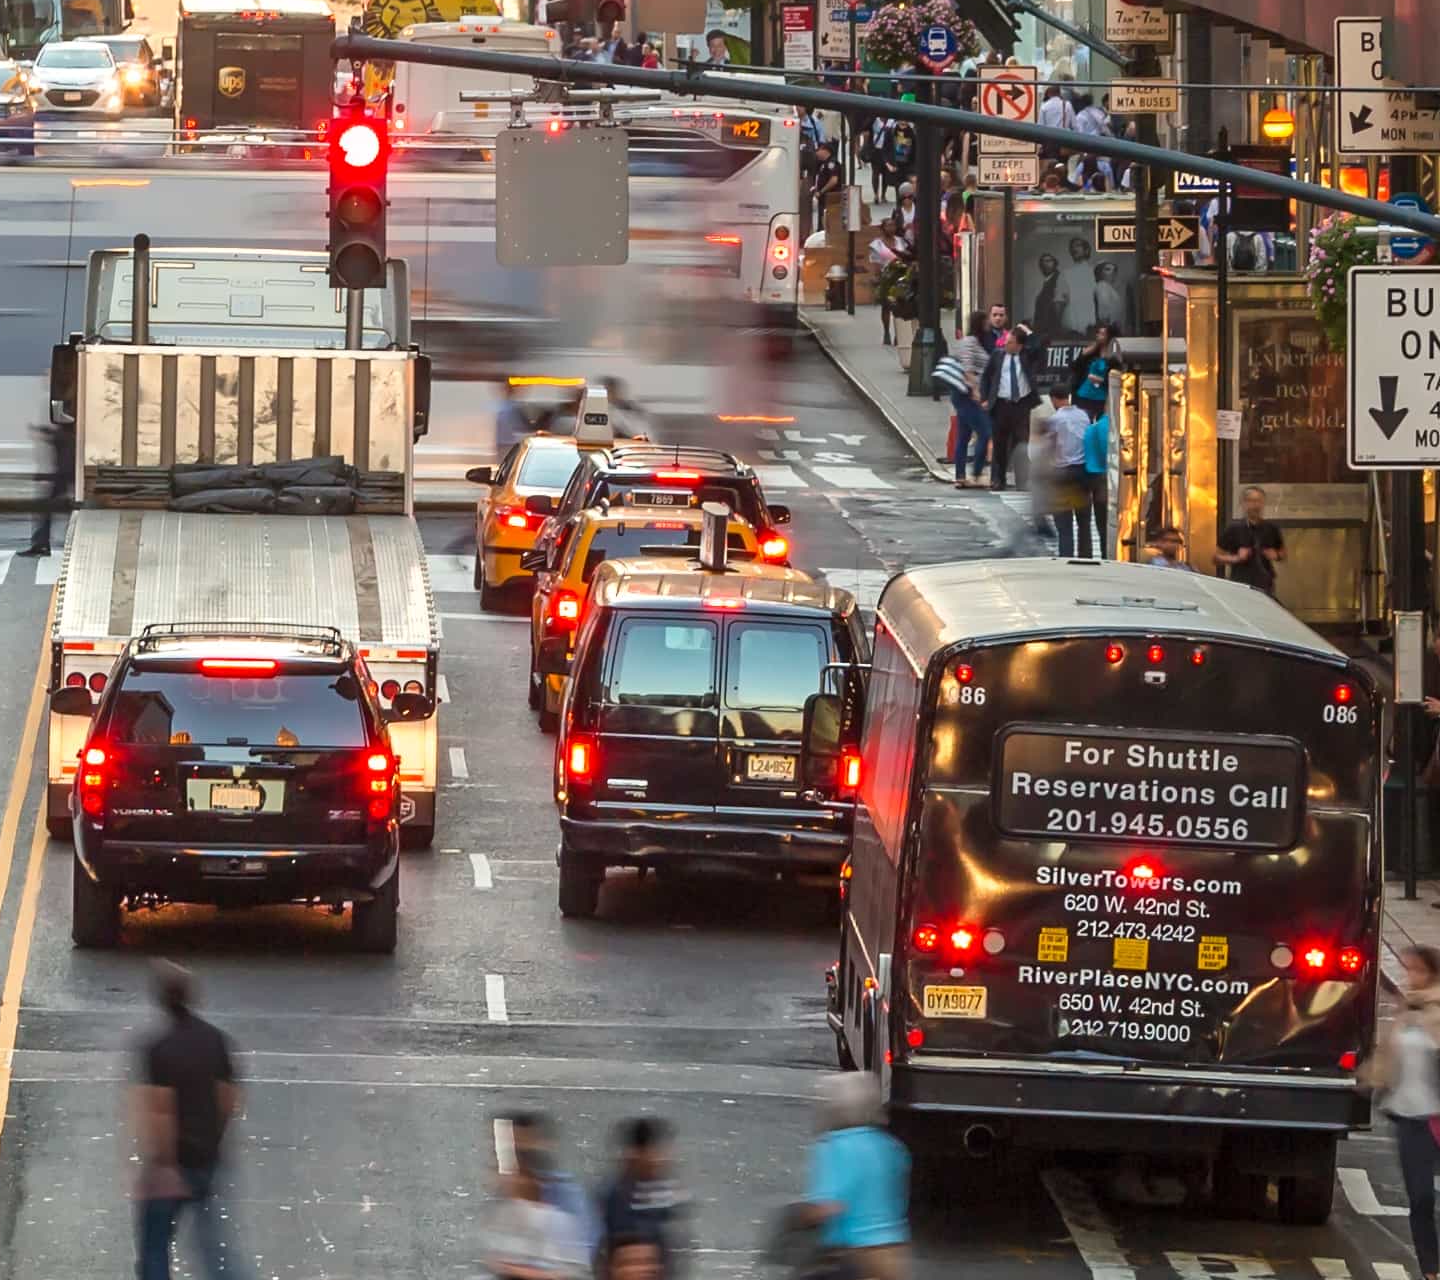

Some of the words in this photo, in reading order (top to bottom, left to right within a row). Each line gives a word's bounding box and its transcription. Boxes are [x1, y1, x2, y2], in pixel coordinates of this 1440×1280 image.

[1117, 96, 1136, 107] MTA
[1139, 96, 1171, 108] BUSES
[1380, 127, 1406, 140] MON
[984, 172, 1001, 181] MTA
[992, 160, 1025, 169] EXCEPT
[1047, 345, 1070, 367] THE
[1276, 383, 1332, 399] never
[1322, 704, 1358, 724] 086
[1064, 741, 1116, 766] For
[1126, 744, 1240, 773] Shuttle
[1011, 771, 1216, 807] Reservations
[1228, 784, 1289, 810] Call
[1046, 807, 1249, 842] 201.945.0556
[1036, 865, 1243, 896] SilverTowers.com
[1063, 893, 1099, 913] 620
[1104, 895, 1128, 915] W.
[1133, 897, 1181, 917] 42nd
[1185, 900, 1211, 919] St.
[1076, 919, 1196, 943] 212.473.4242
[1017, 965, 1250, 995] RiverPlaceNYC.com
[1058, 993, 1095, 1012] 650
[1099, 995, 1123, 1014] W.
[1128, 997, 1176, 1017] 42nd
[1179, 999, 1206, 1019] St.
[1070, 1019, 1191, 1043] 212.719.9000
